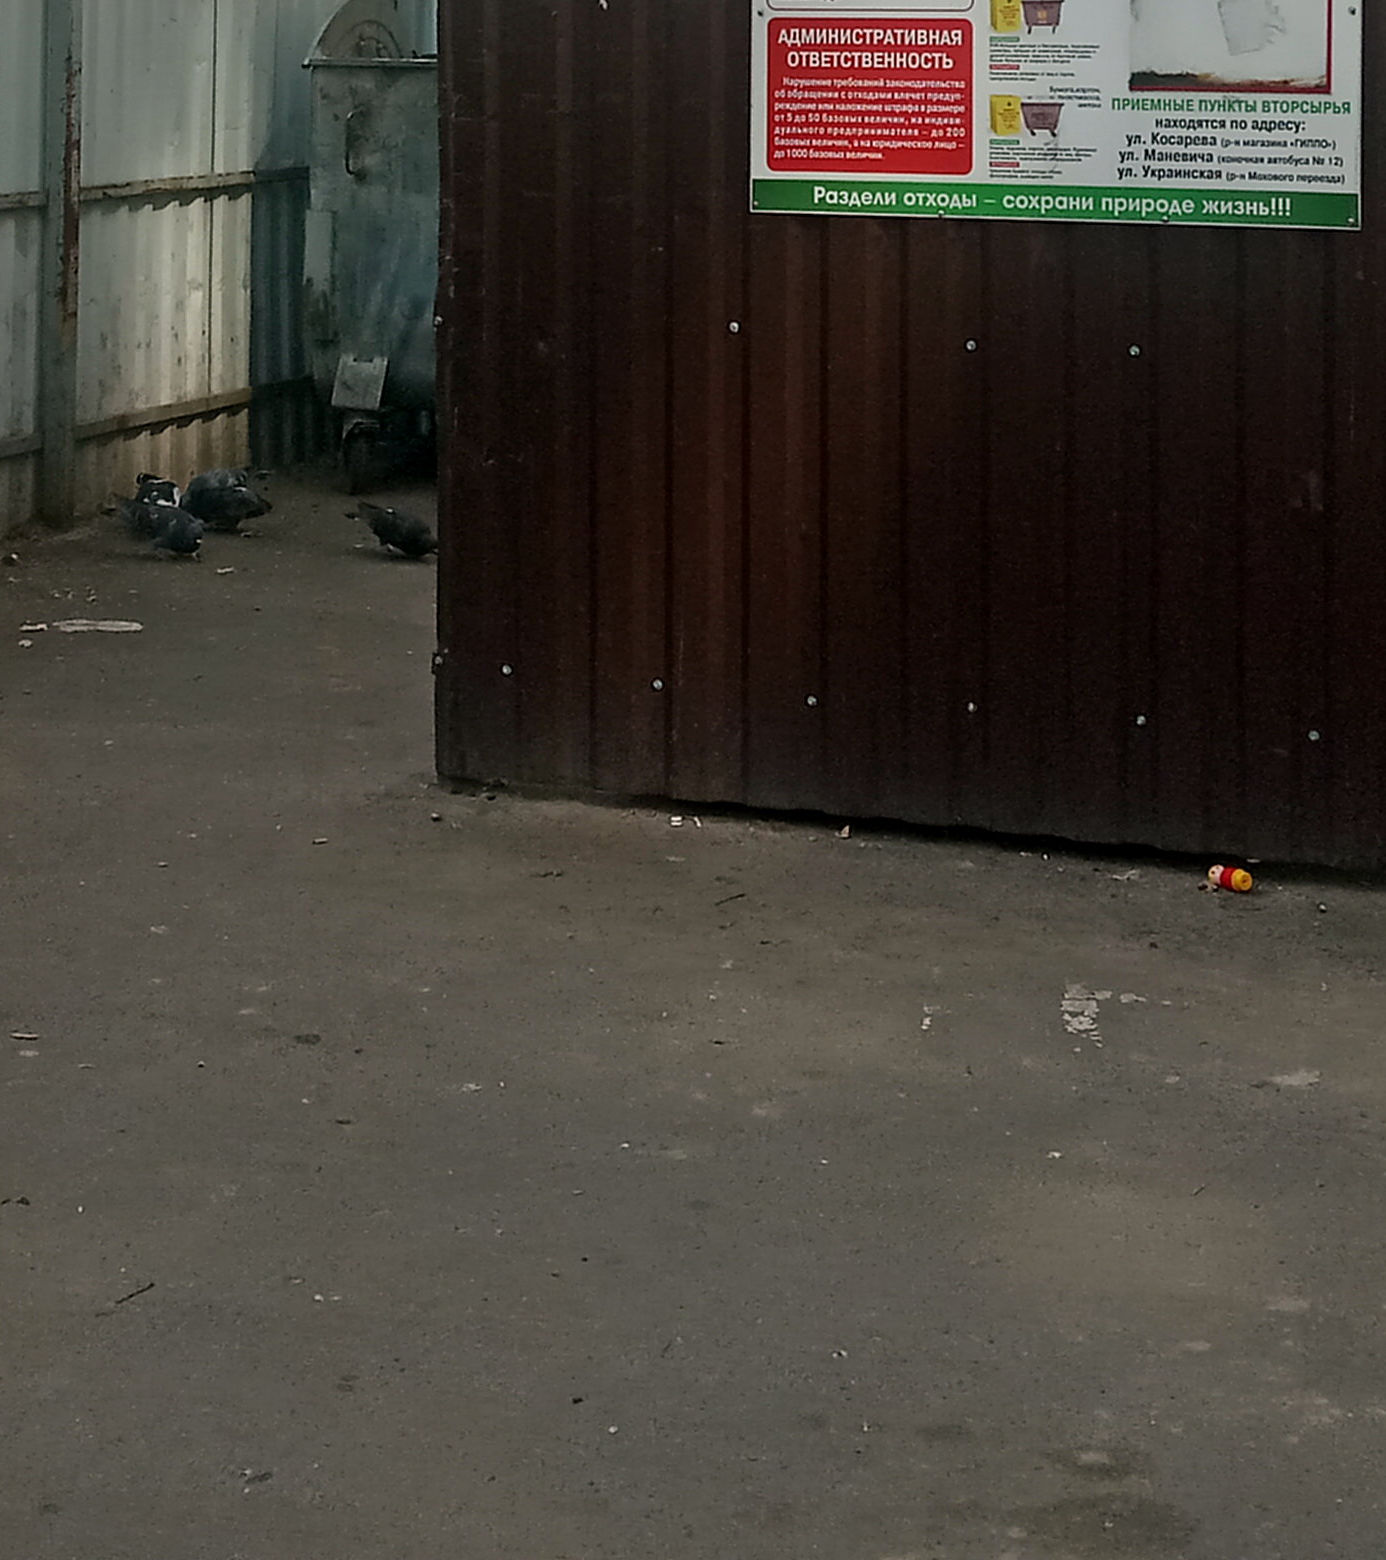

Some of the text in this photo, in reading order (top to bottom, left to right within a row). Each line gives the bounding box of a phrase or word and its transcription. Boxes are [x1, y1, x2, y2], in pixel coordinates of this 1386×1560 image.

[778, 28, 962, 47] АДМИНИСТРАТИВНАЯ
[787, 51, 954, 69] ОТВЕТСТВЕННОСТЬ
[1112, 97, 1194, 112] ПРИЕМНЫЕ
[1199, 98, 1257, 113] ПУНКТЫ
[1262, 100, 1351, 114] ВТОРСЫРЬЯ
[946, 127, 965, 137] 200
[1155, 117, 1306, 133] находятся по адресу:
[1126, 134, 1146, 148] ул.
[1151, 133, 1217, 148] Косарева
[1243, 139, 1288, 148] магазина
[1119, 150, 1139, 164] ул.
[1144, 149, 1214, 163] Маневича
[1117, 167, 1137, 181] ул.
[1142, 165, 1222, 181] Украинская
[813, 186, 896, 207] Раздели
[903, 192, 977, 209] отходы
[1002, 196, 1096, 214] сохрани
[1101, 197, 1195, 216] природе
[1202, 197, 1291, 216] жизнь!!!
